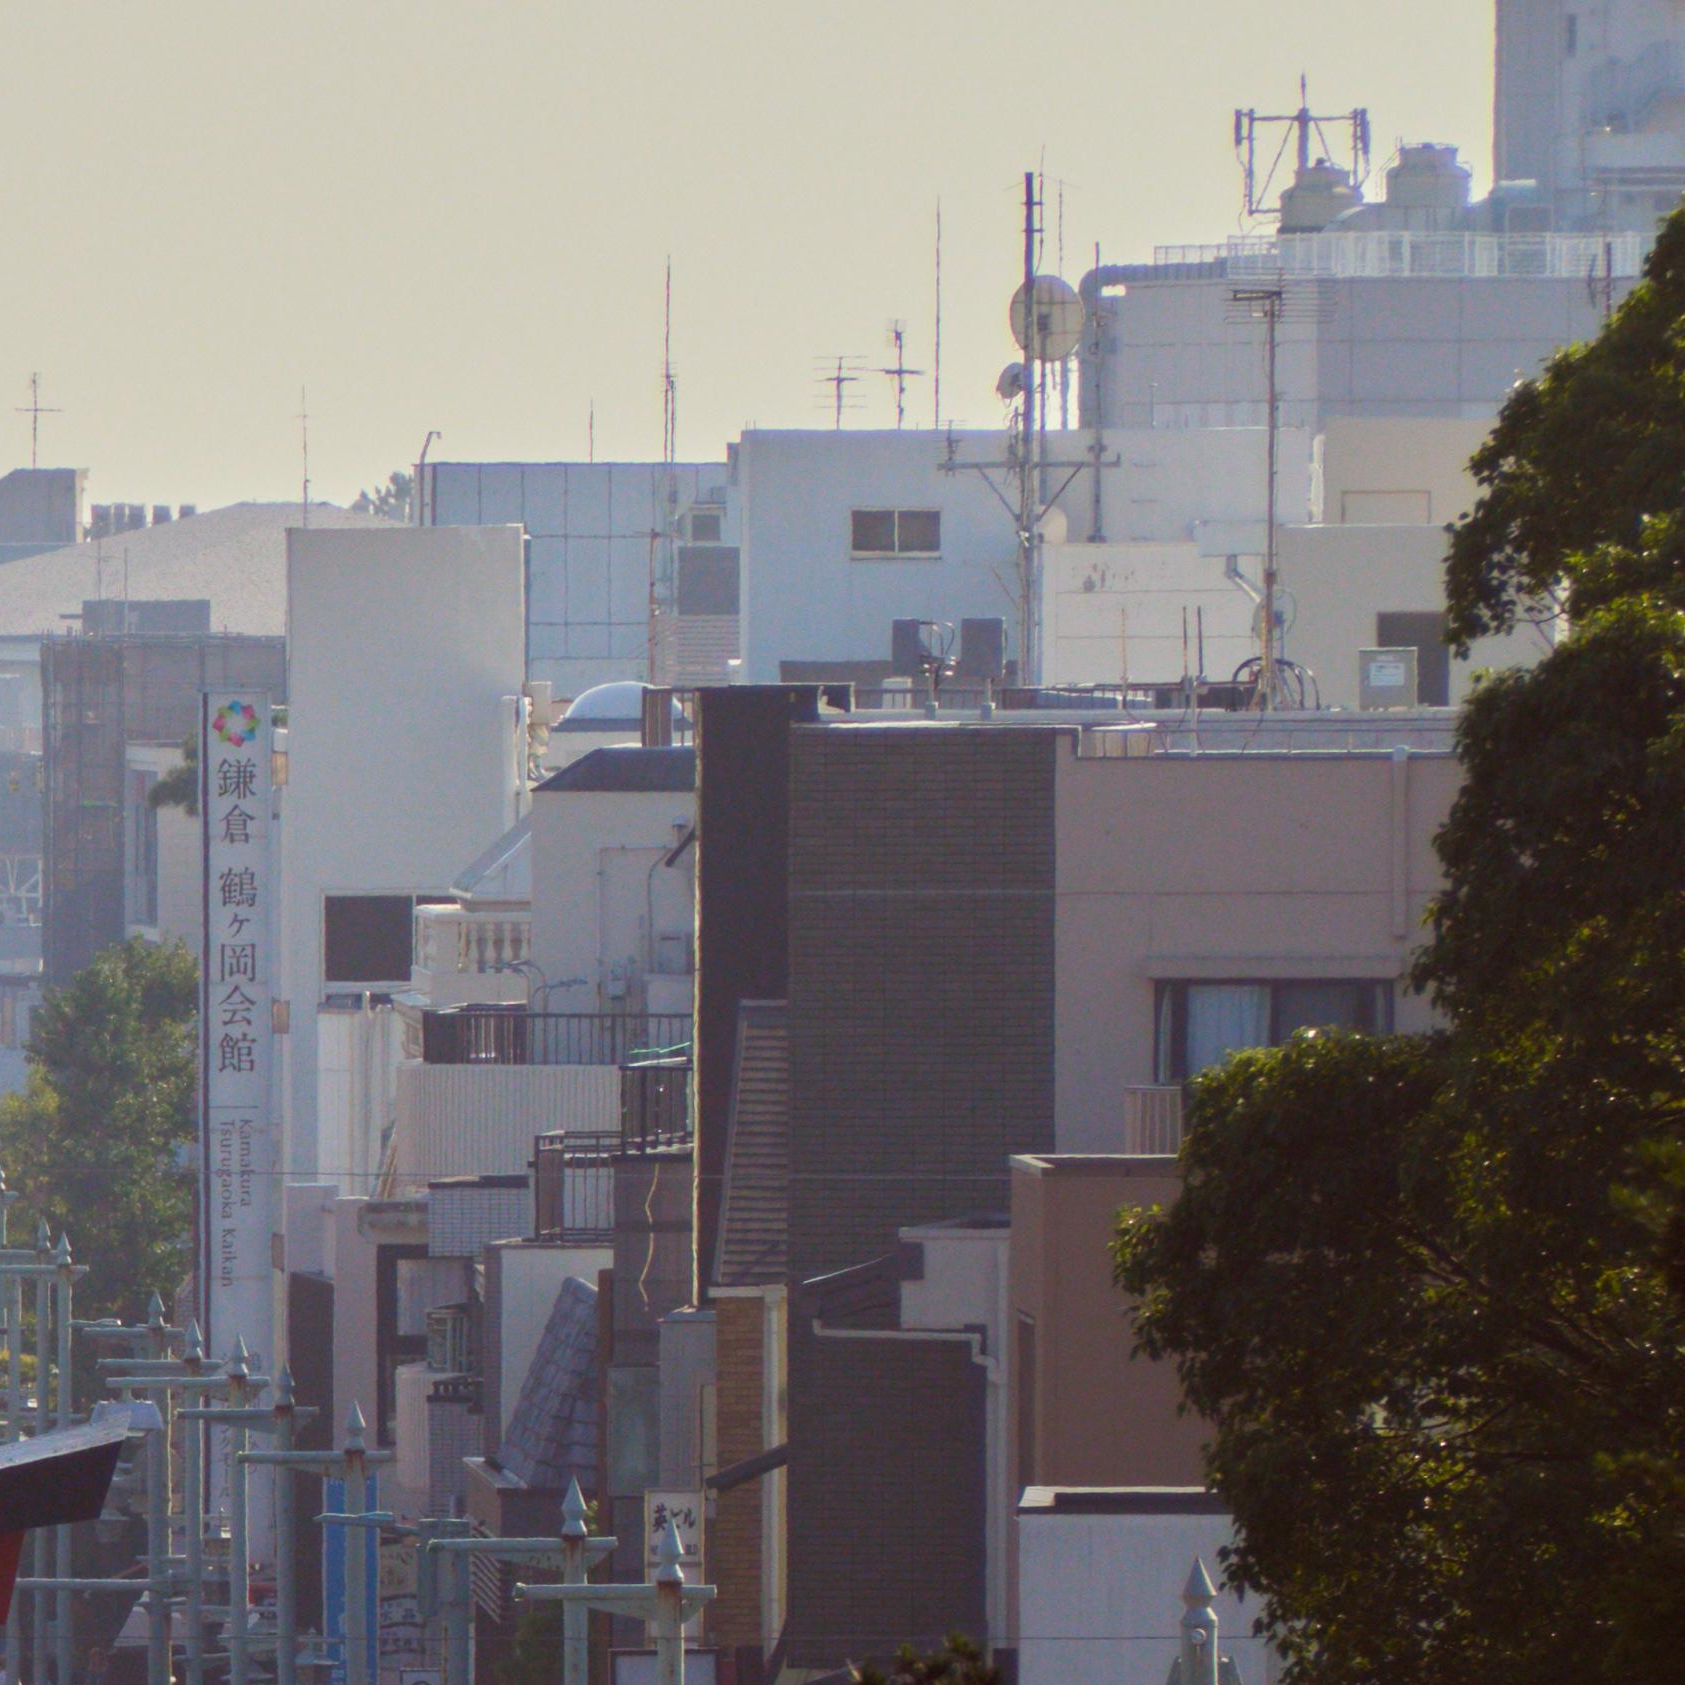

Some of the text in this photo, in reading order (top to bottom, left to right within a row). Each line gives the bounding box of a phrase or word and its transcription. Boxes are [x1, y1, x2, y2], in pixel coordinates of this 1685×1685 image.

[218, 757, 257, 844] 鎌倉
[215, 1119, 238, 1288] Tsurugaoka Kaikan
[239, 1118, 256, 1208] Kamakura
